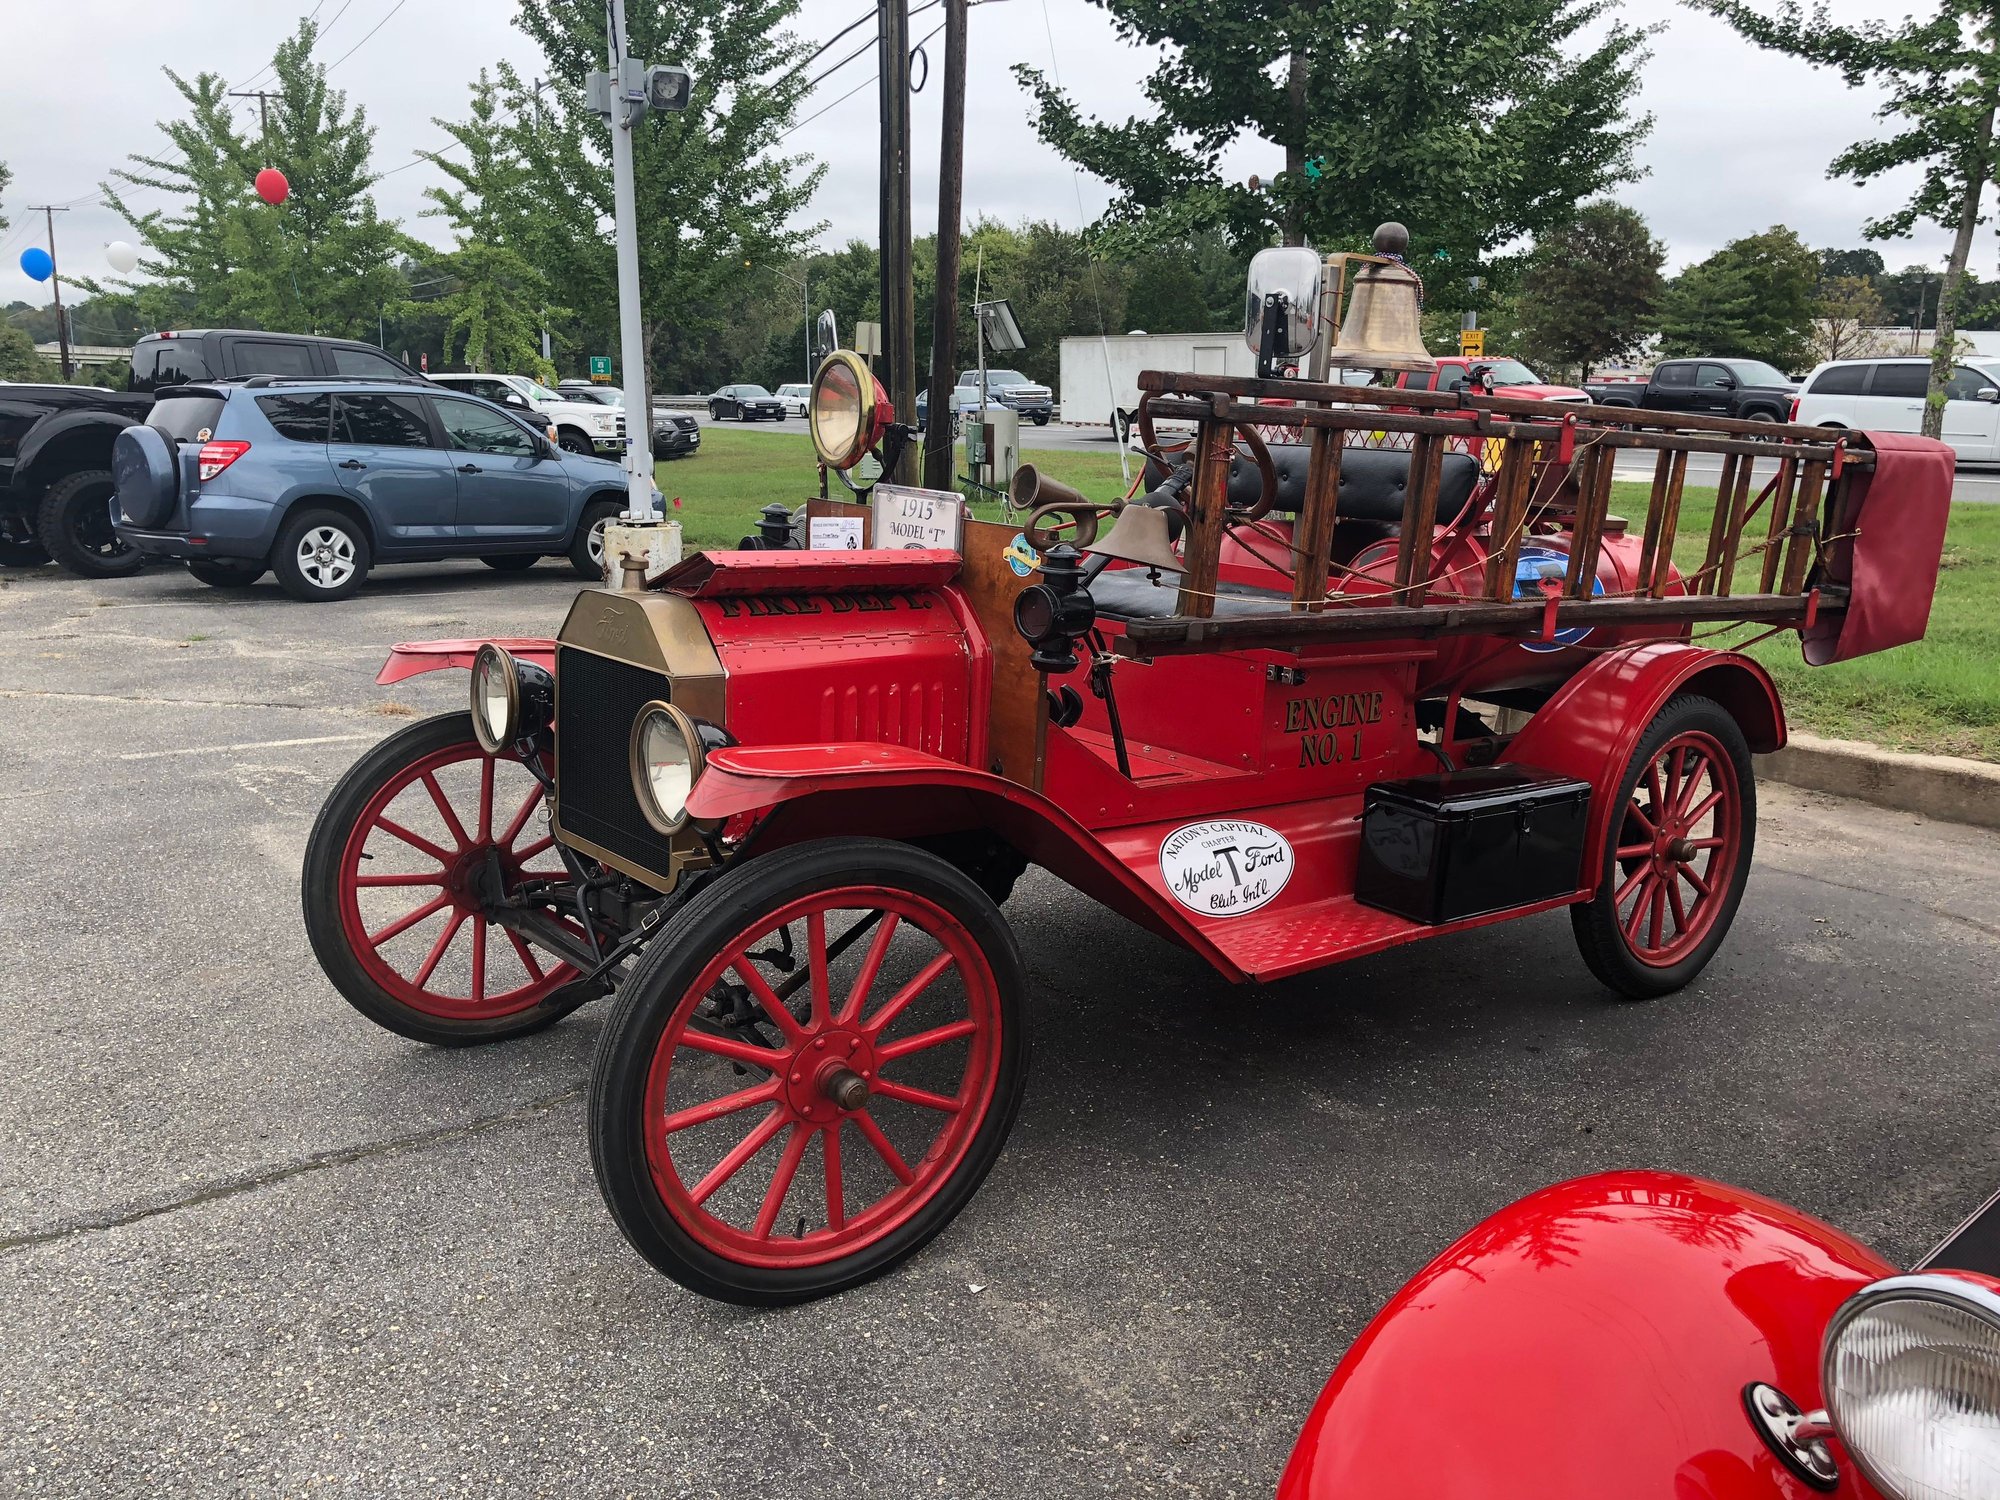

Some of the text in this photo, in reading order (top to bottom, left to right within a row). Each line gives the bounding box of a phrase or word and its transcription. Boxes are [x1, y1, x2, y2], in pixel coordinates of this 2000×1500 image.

[901, 499, 934, 520] 1915
[889, 521, 925, 540] MODEL
[1284, 691, 1383, 733] ENGINE
[1299, 730, 1362, 768] NO. 1
[1166, 823, 1267, 860] NATION'S CAPITAL
[1201, 835, 1237, 849] CHAPTER
[1174, 841, 1285, 899] Model T Ford
[1210, 890, 1238, 909] Club
